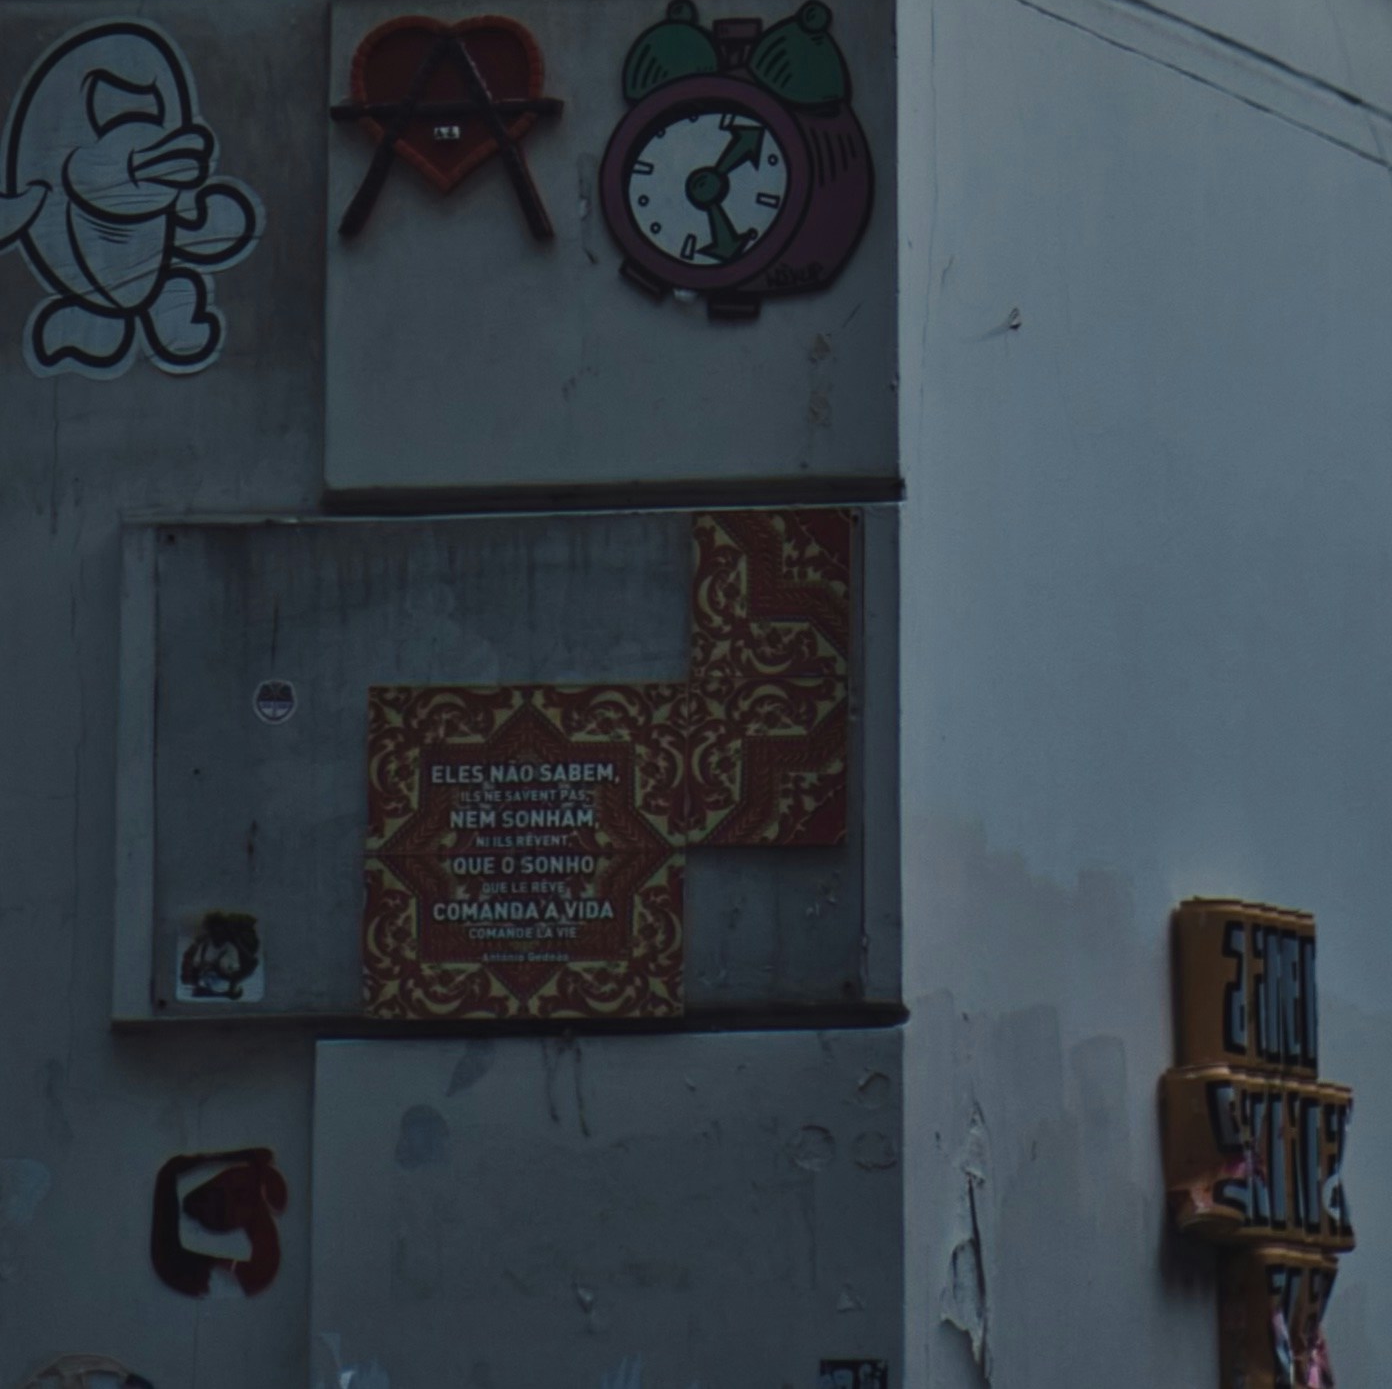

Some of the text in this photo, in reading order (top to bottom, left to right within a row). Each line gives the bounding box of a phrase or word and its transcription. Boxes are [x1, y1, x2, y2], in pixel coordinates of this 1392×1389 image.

[431, 760, 620, 784] ELES NÃO SABEM,
[461, 791, 481, 802] ILS
[484, 791, 502, 802] NE
[505, 790, 556, 801] SAVENT
[450, 809, 600, 829] NEM SONHAM,
[476, 836, 490, 847] NI
[493, 836, 513, 847] ILS
[453, 856, 594, 875] QUE O SONHO
[482, 882, 508, 894] QUE
[511, 881, 528, 894] LE
[433, 901, 614, 921] COMANDA A VIDA
[469, 926, 577, 939] COMANDE LA VIE
